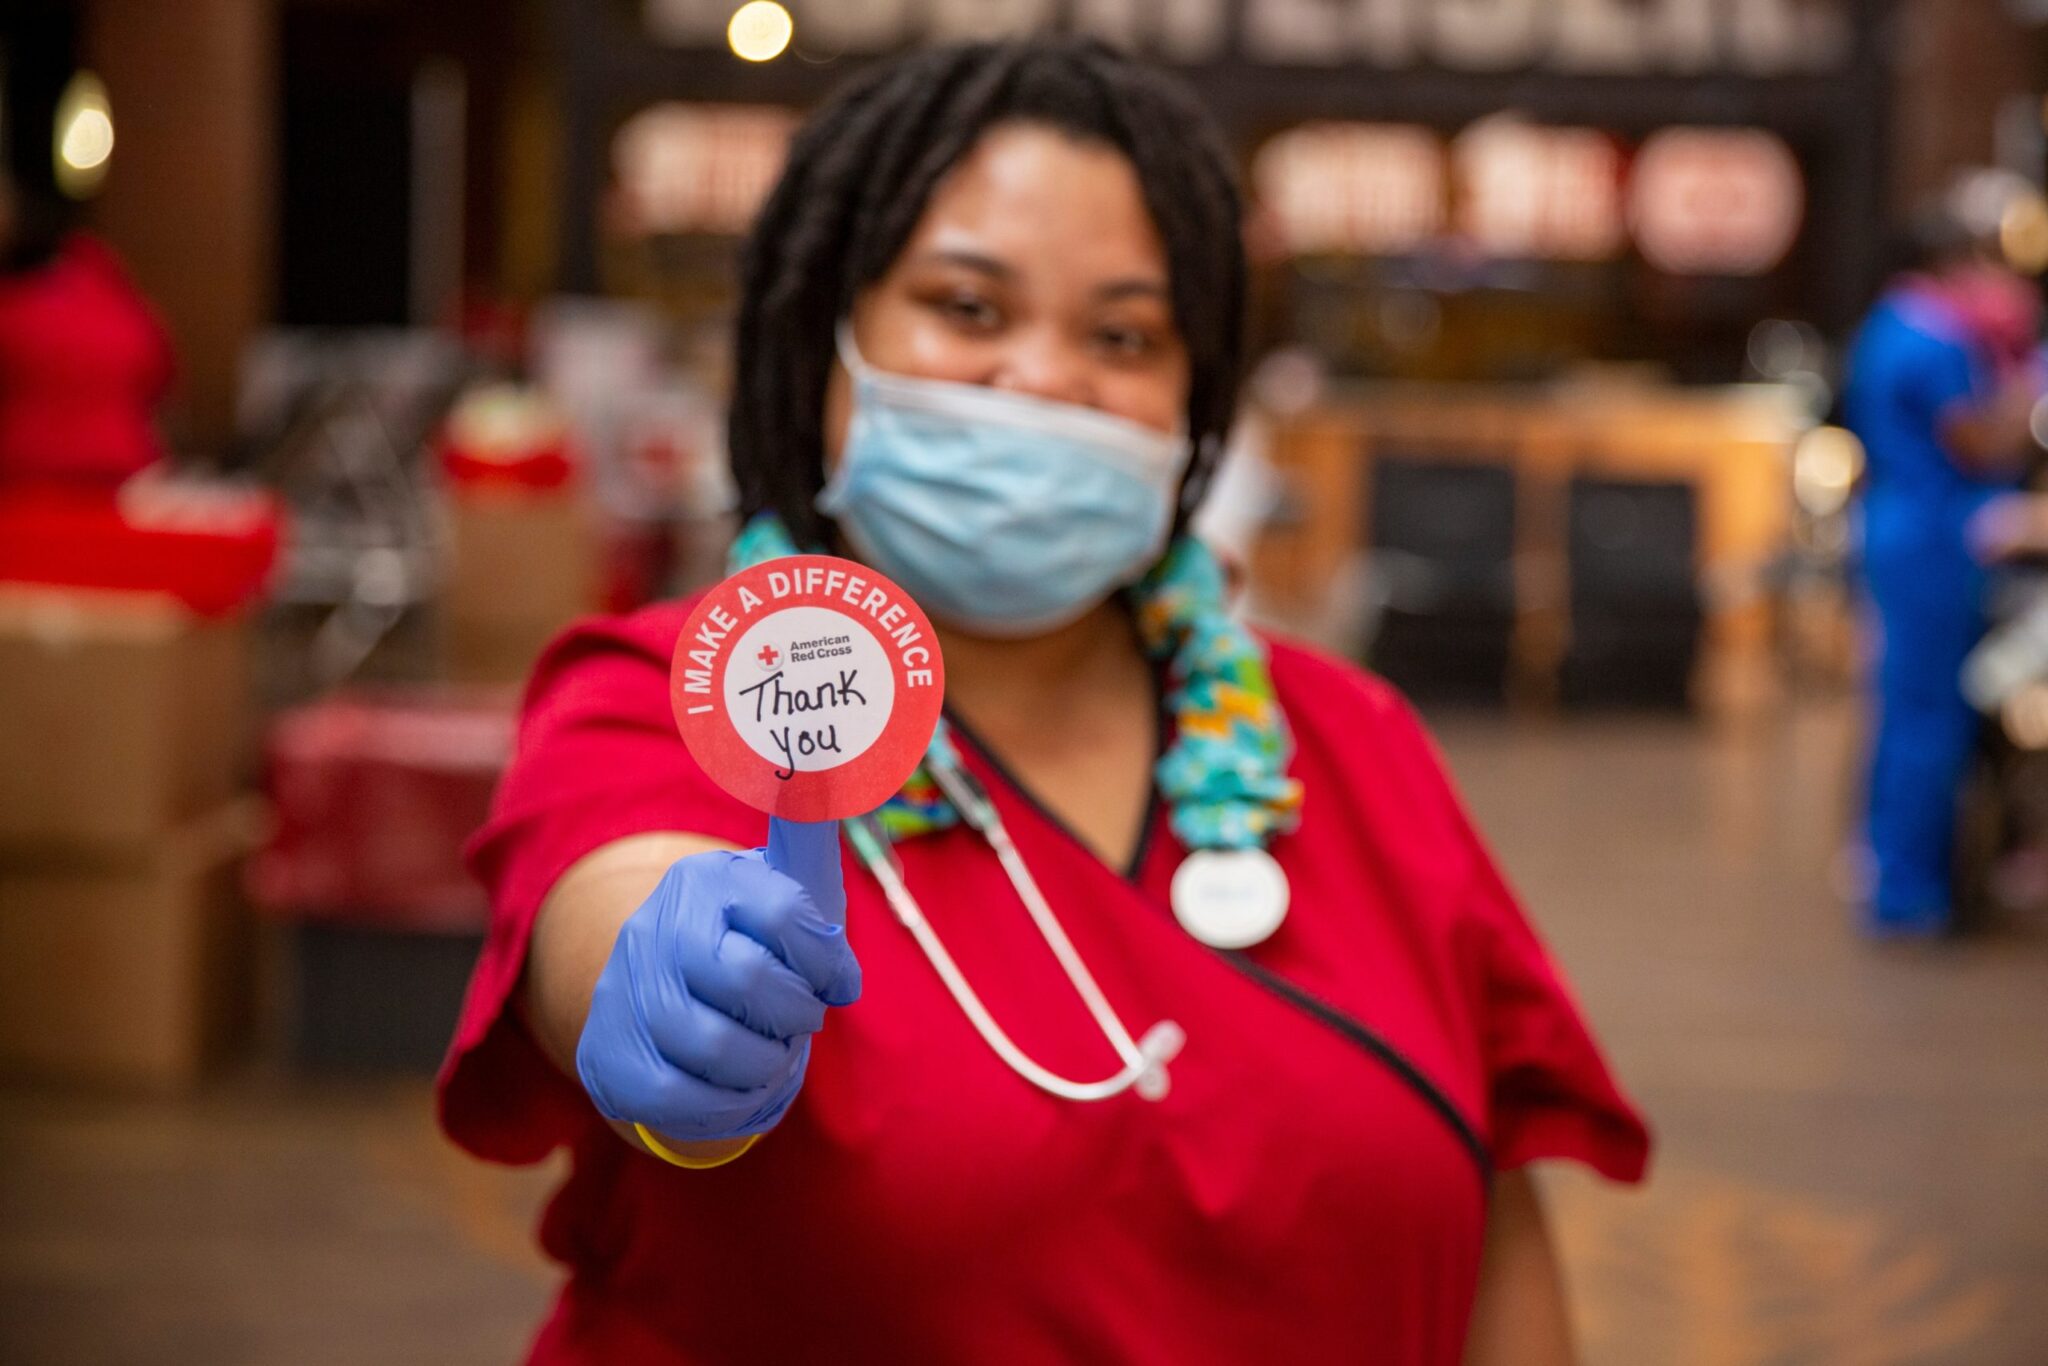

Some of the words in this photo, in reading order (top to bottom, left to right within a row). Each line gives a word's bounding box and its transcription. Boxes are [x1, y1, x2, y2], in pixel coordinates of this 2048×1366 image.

[737, 585, 763, 614] A
[767, 568, 933, 688] DIFFERENCE
[790, 634, 850, 652] American
[684, 605, 738, 694] MAKE
[790, 650, 815, 663] Red
[816, 644, 853, 659] Cross
[687, 704, 714, 715] I
[739, 669, 867, 722] Thank
[769, 724, 841, 781] you
